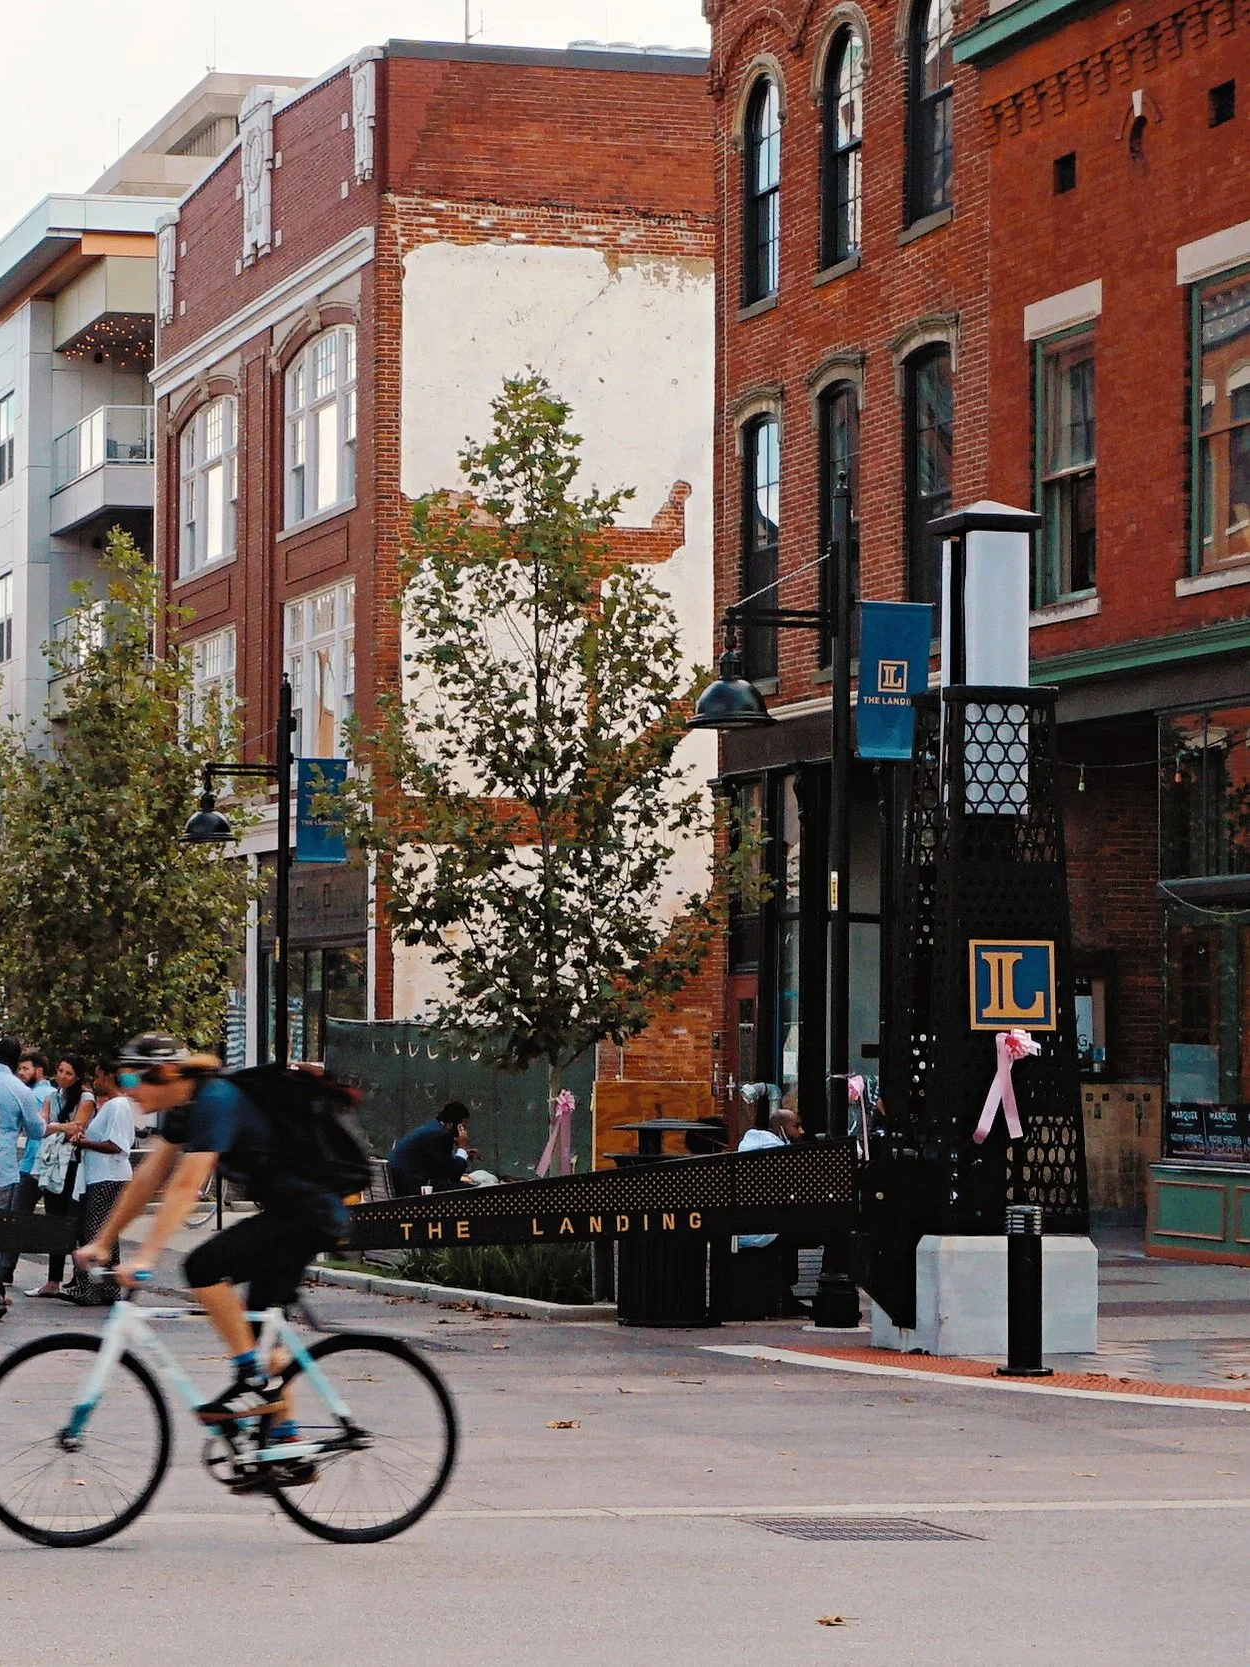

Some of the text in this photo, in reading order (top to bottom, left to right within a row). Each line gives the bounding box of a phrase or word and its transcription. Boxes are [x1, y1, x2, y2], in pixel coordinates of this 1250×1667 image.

[863, 696, 881, 704] THE
[400, 1212, 702, 1240] THE LANDING
